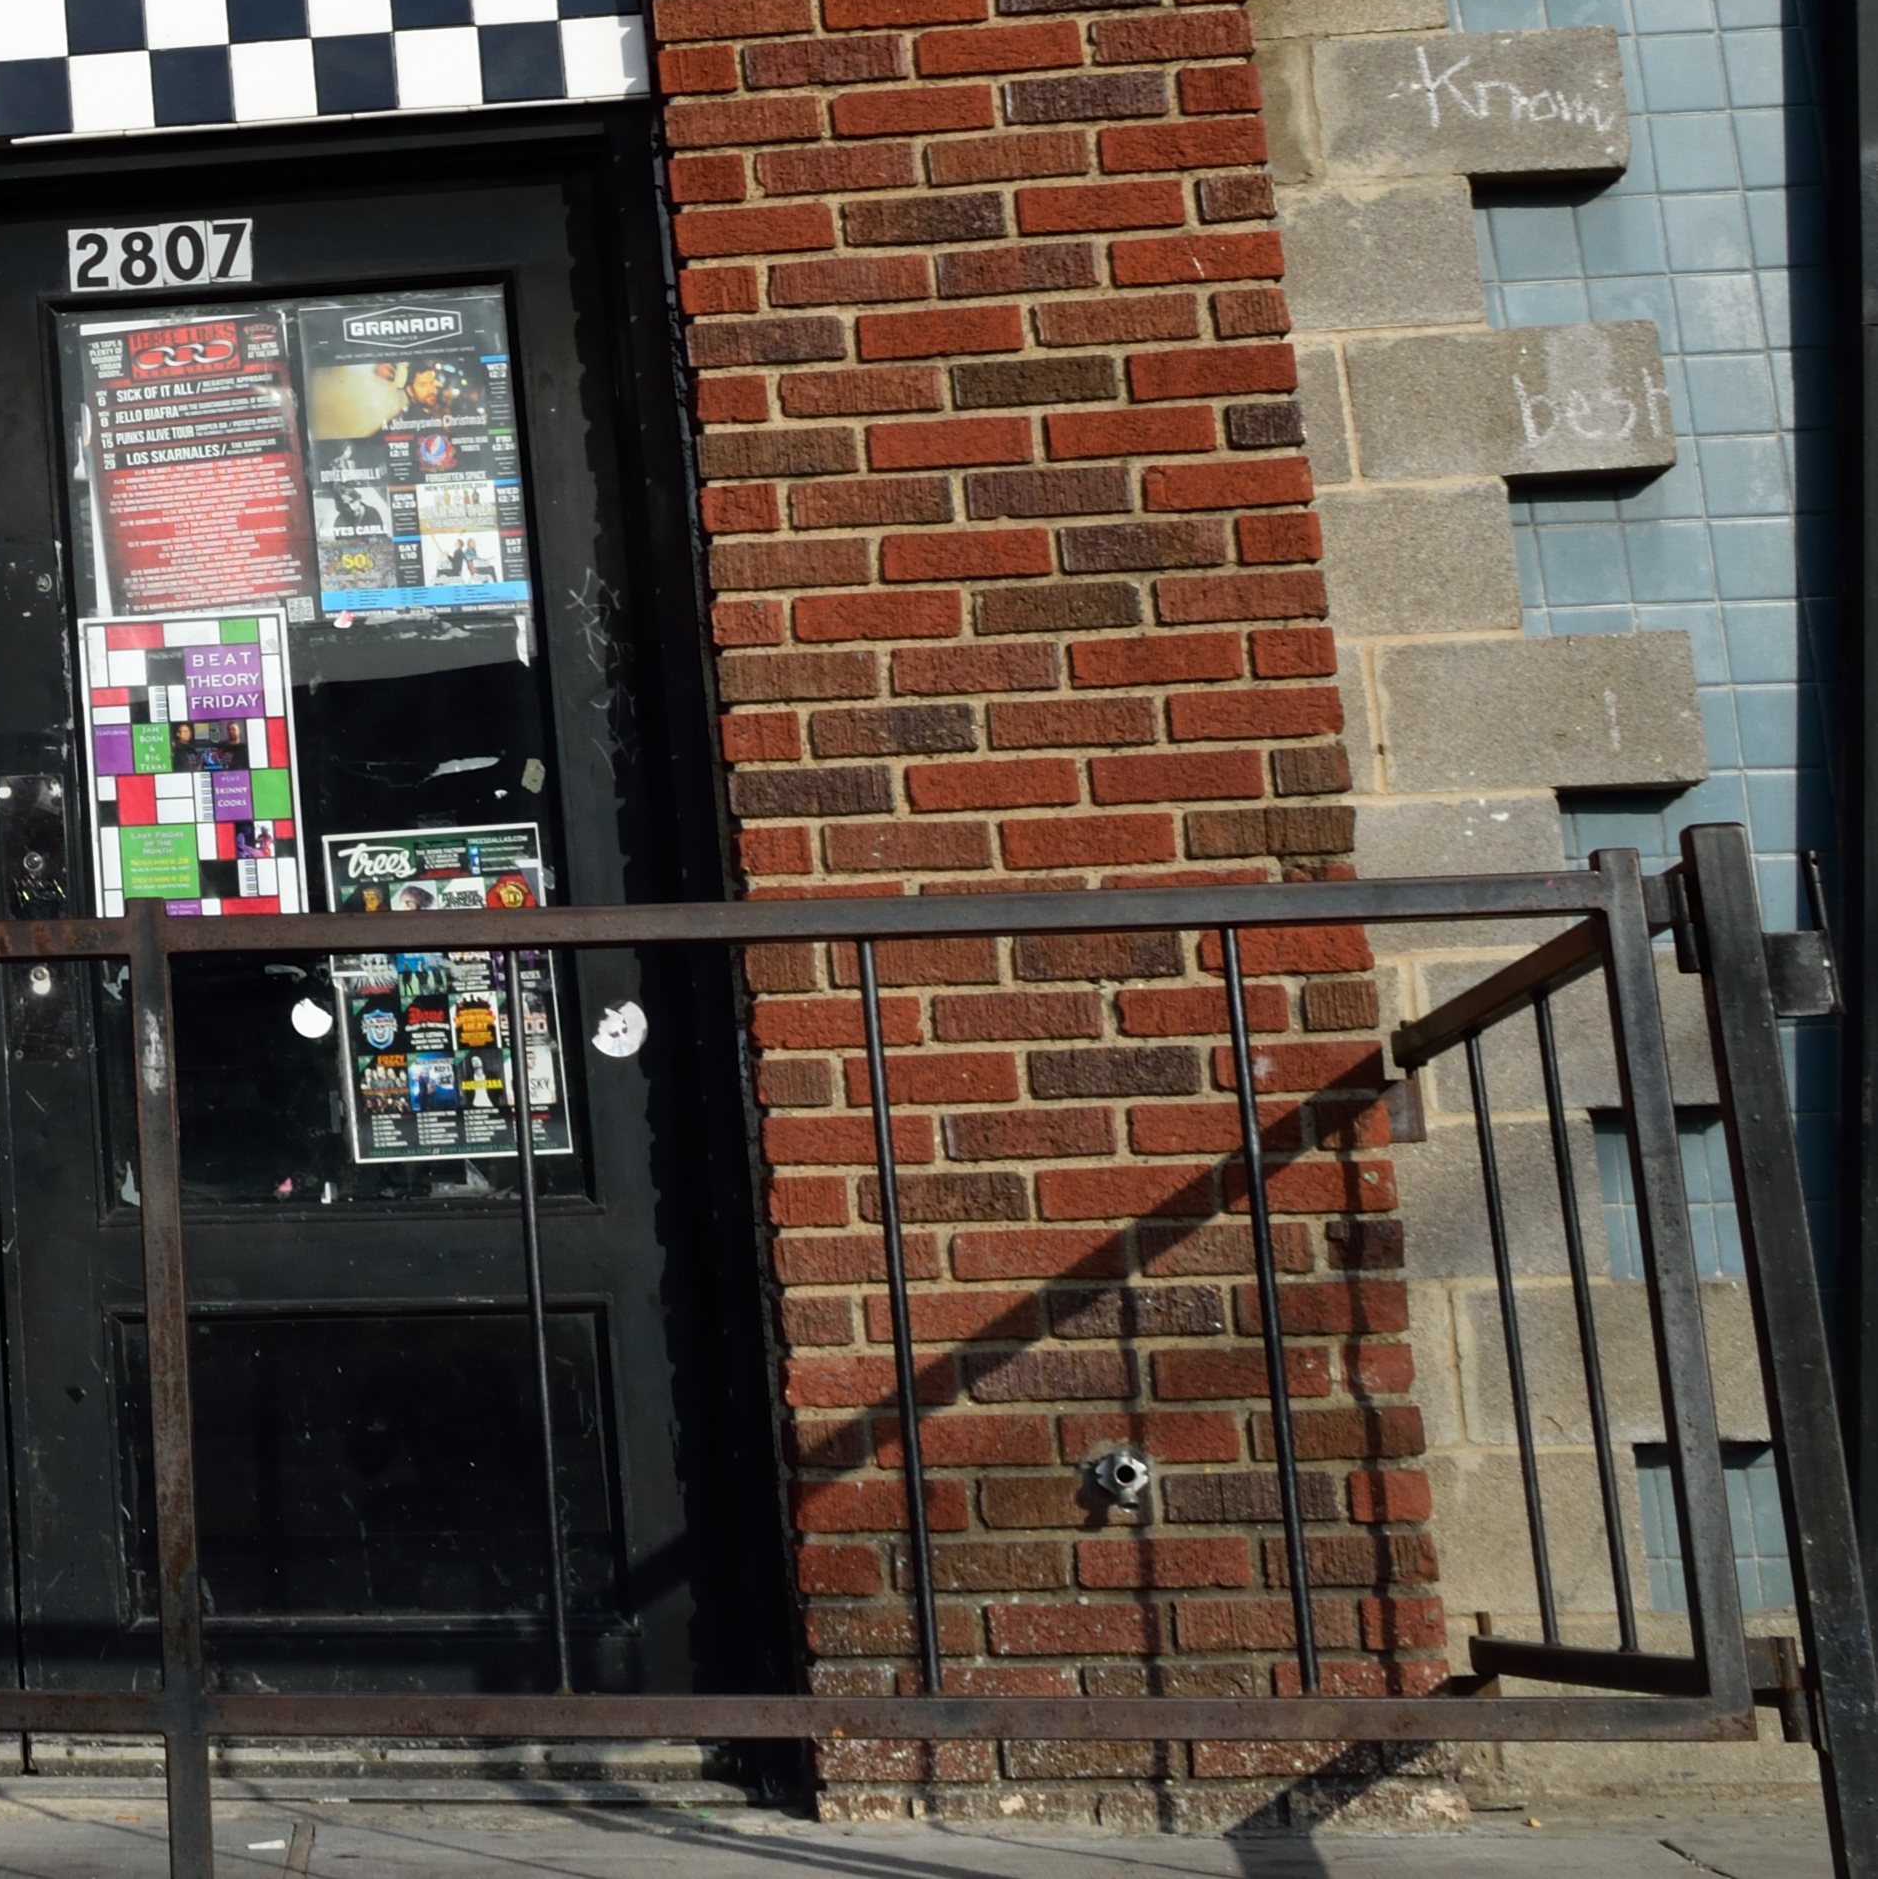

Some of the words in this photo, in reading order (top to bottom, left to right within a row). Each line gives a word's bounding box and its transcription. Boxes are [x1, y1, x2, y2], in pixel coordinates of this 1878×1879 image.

[75, 219, 252, 288] 2807
[351, 316, 455, 336] GRANADA
[116, 388, 142, 403] SICK
[144, 386, 159, 399] OF
[161, 384, 172, 397] IT
[174, 382, 194, 396] ALL
[115, 408, 143, 424] JELLO
[145, 406, 179, 420] BIAFRA
[444, 415, 487, 427] Christmas
[116, 431, 145, 445] PUNKS
[146, 428, 170, 442] ALIVE
[171, 425, 194, 439] TOUR
[126, 452, 149, 466] LOS
[151, 444, 220, 462] SKARNALES
[192, 652, 252, 667] BEAT
[186, 673, 259, 688] THEORY
[191, 693, 259, 710] FRIDAY
[140, 735, 163, 743] BORN
[155, 831, 184, 839] FRIDAY
[130, 858, 175, 867] NOVEMBER
[132, 876, 175, 884] DECEMBER
